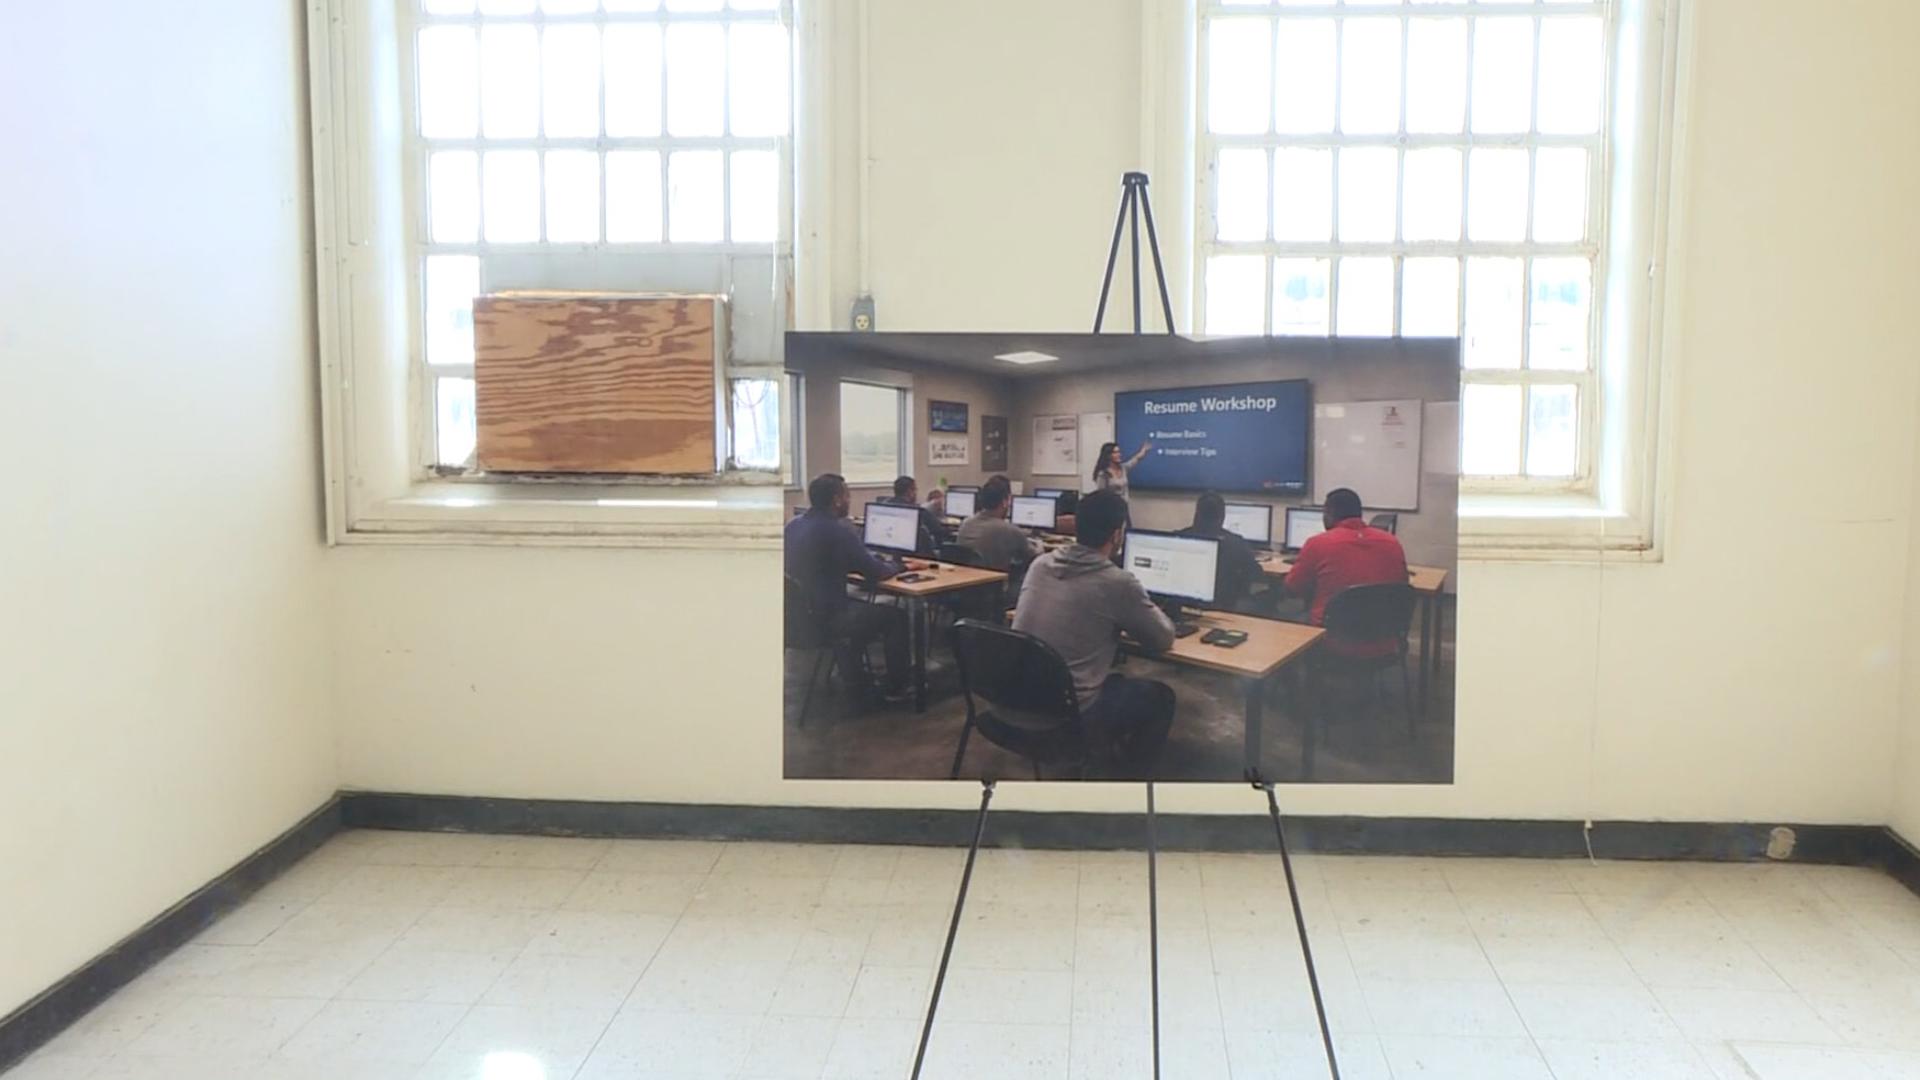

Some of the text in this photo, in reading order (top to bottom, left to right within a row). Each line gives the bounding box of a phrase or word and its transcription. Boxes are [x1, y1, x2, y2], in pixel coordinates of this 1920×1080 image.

[1144, 395, 1277, 414] Resume Workshop
[1200, 447, 1217, 457] Tips
